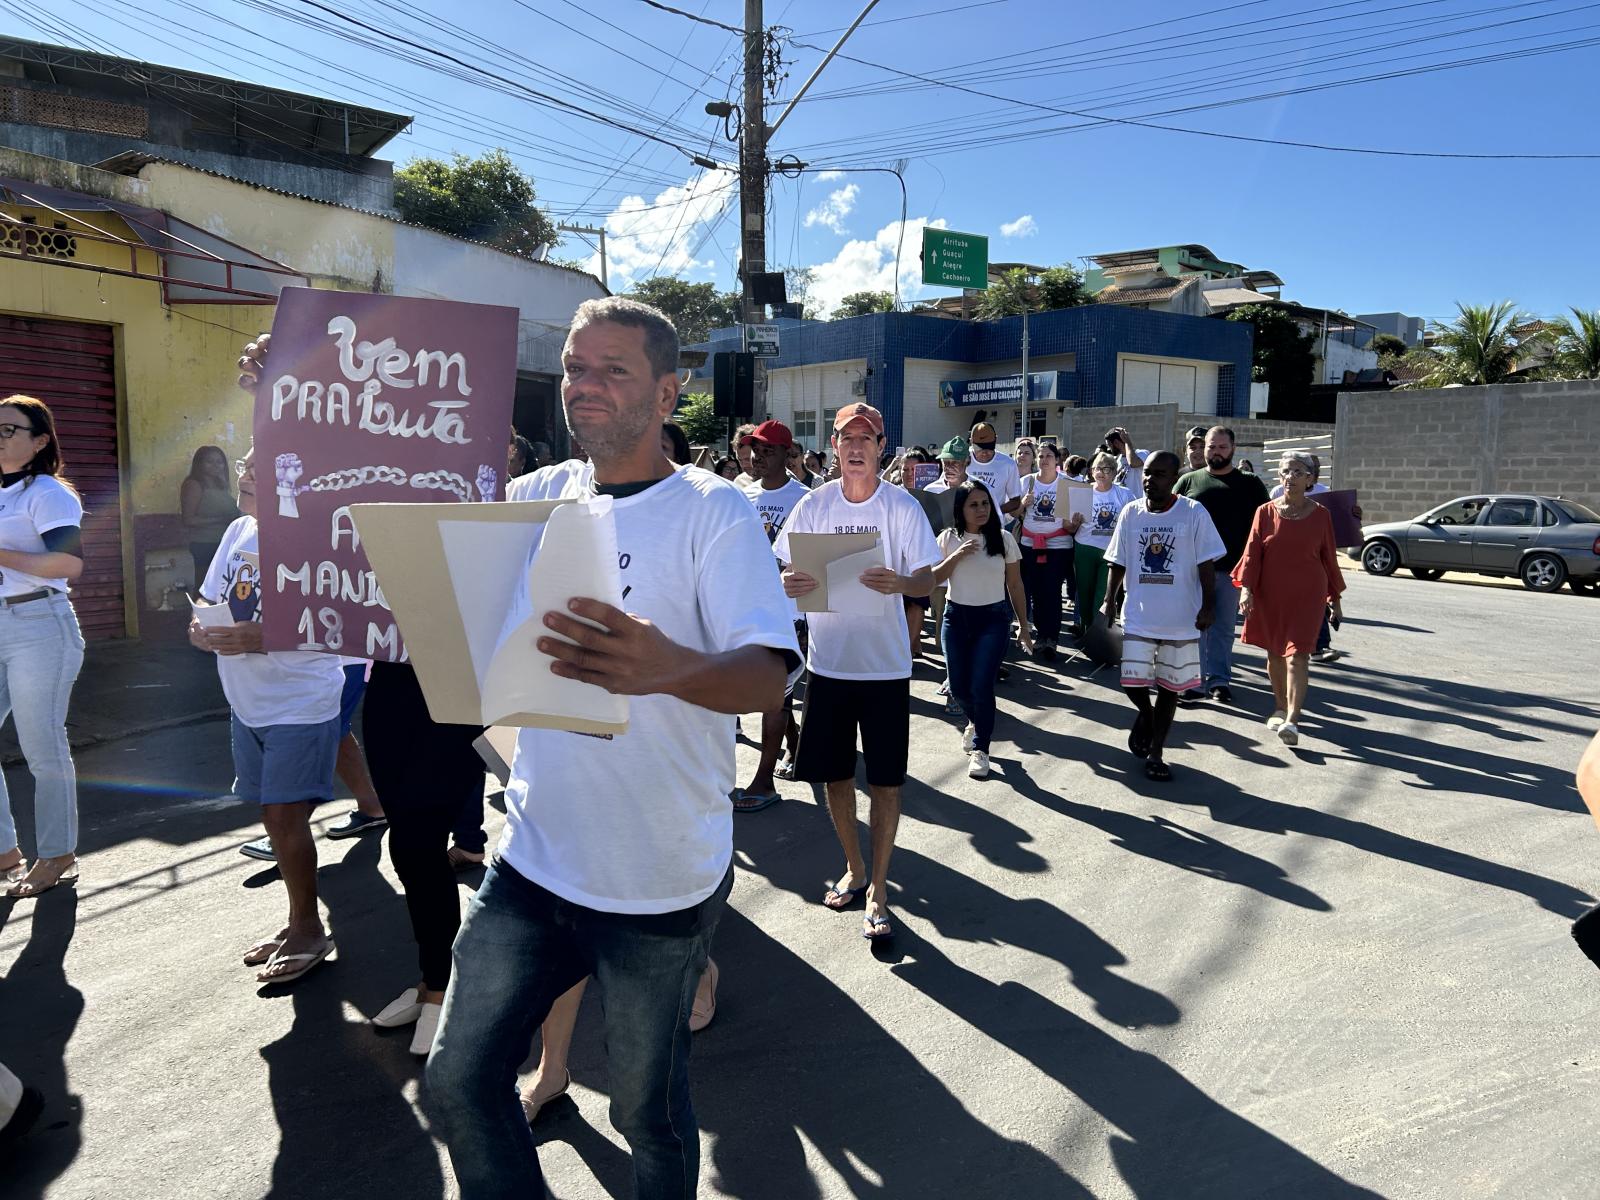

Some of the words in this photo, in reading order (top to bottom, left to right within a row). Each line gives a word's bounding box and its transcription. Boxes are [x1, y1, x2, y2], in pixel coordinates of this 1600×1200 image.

[943, 237, 968, 248] Airituba
[942, 261, 962, 270] Alegre
[942, 272, 970, 282] Cachoeiro
[968, 382, 985, 391] CENTRO
[272, 375, 351, 426] PRA
[962, 394, 968, 402] DE
[969, 392, 978, 402] SÃO
[979, 390, 990, 401] JOSÉ
[991, 392, 997, 400] DO
[233, 553, 241, 561] 18
[297, 606, 344, 650] 18
